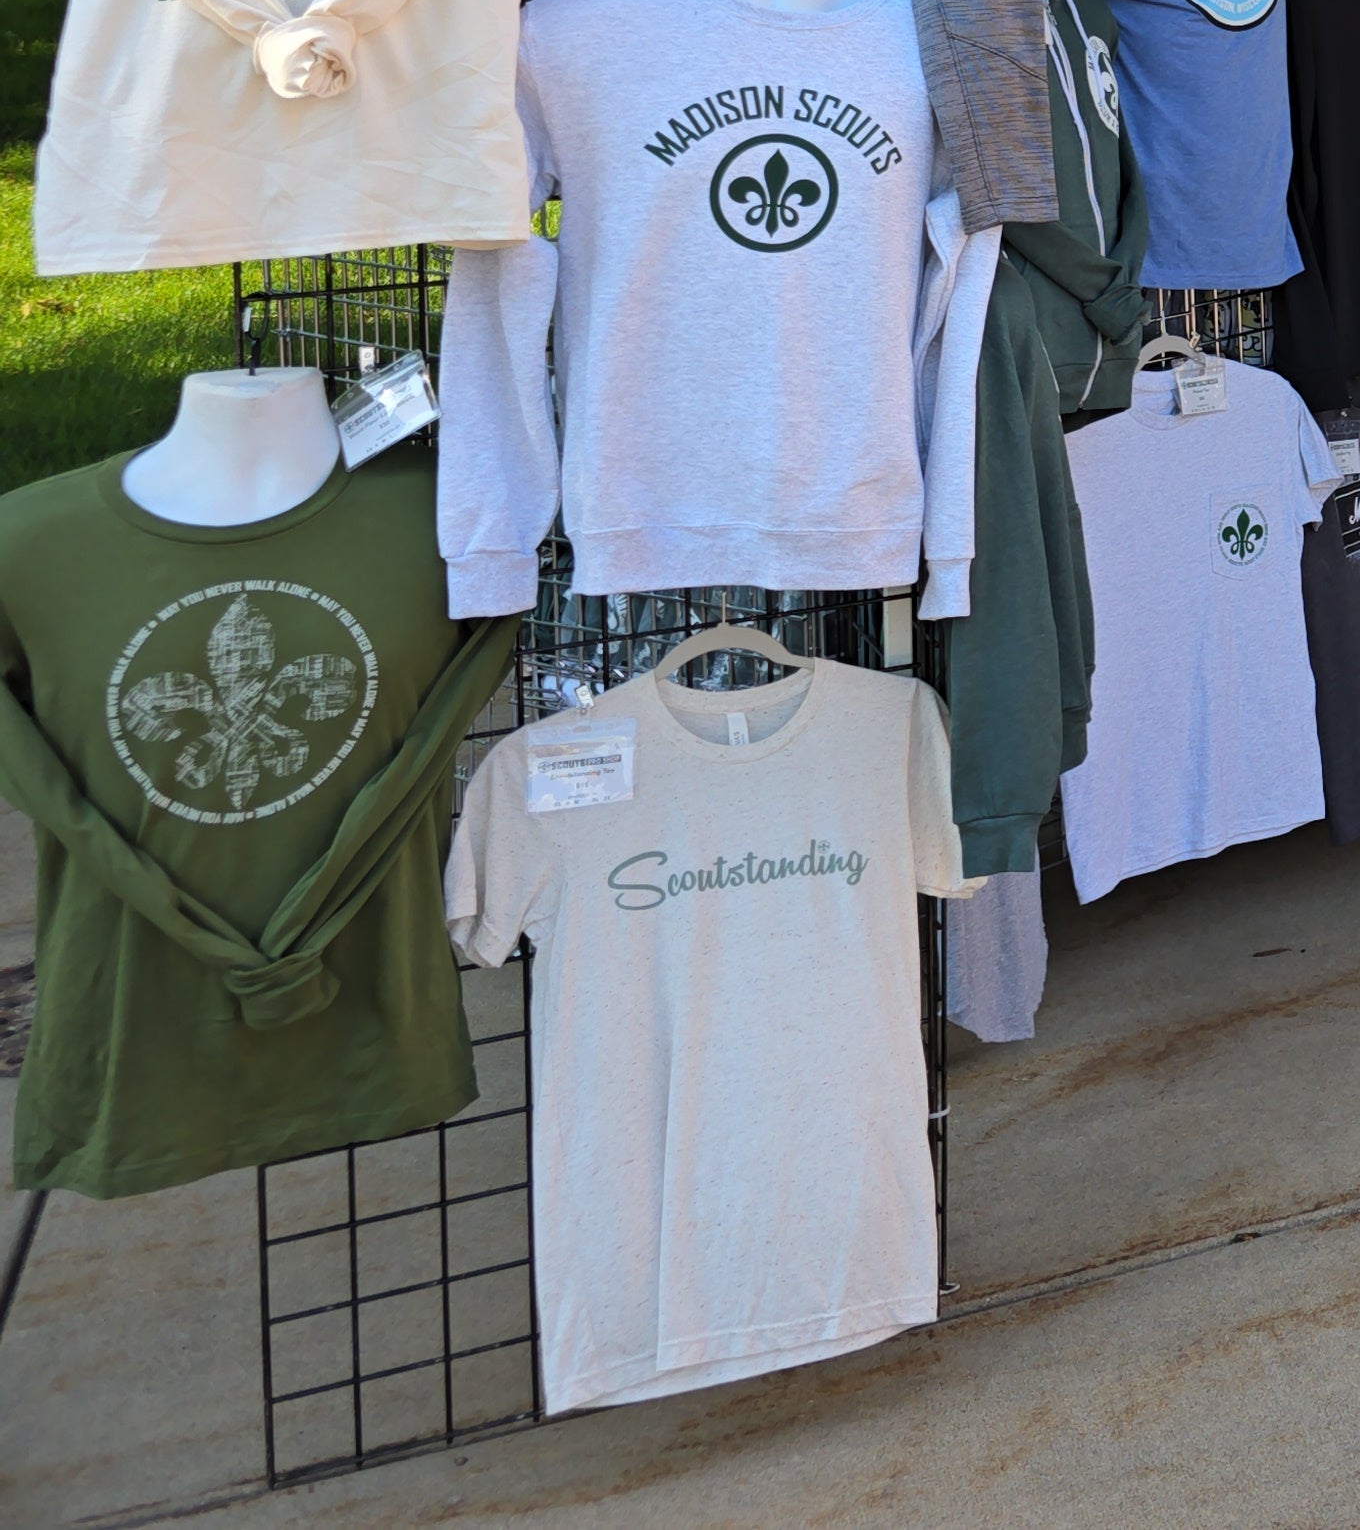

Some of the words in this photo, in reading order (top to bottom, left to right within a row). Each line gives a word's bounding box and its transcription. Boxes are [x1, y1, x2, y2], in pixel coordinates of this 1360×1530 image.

[644, 85, 783, 166] MADISON
[794, 89, 903, 175] SCOUTS
[607, 839, 869, 911] Scoutstanding
